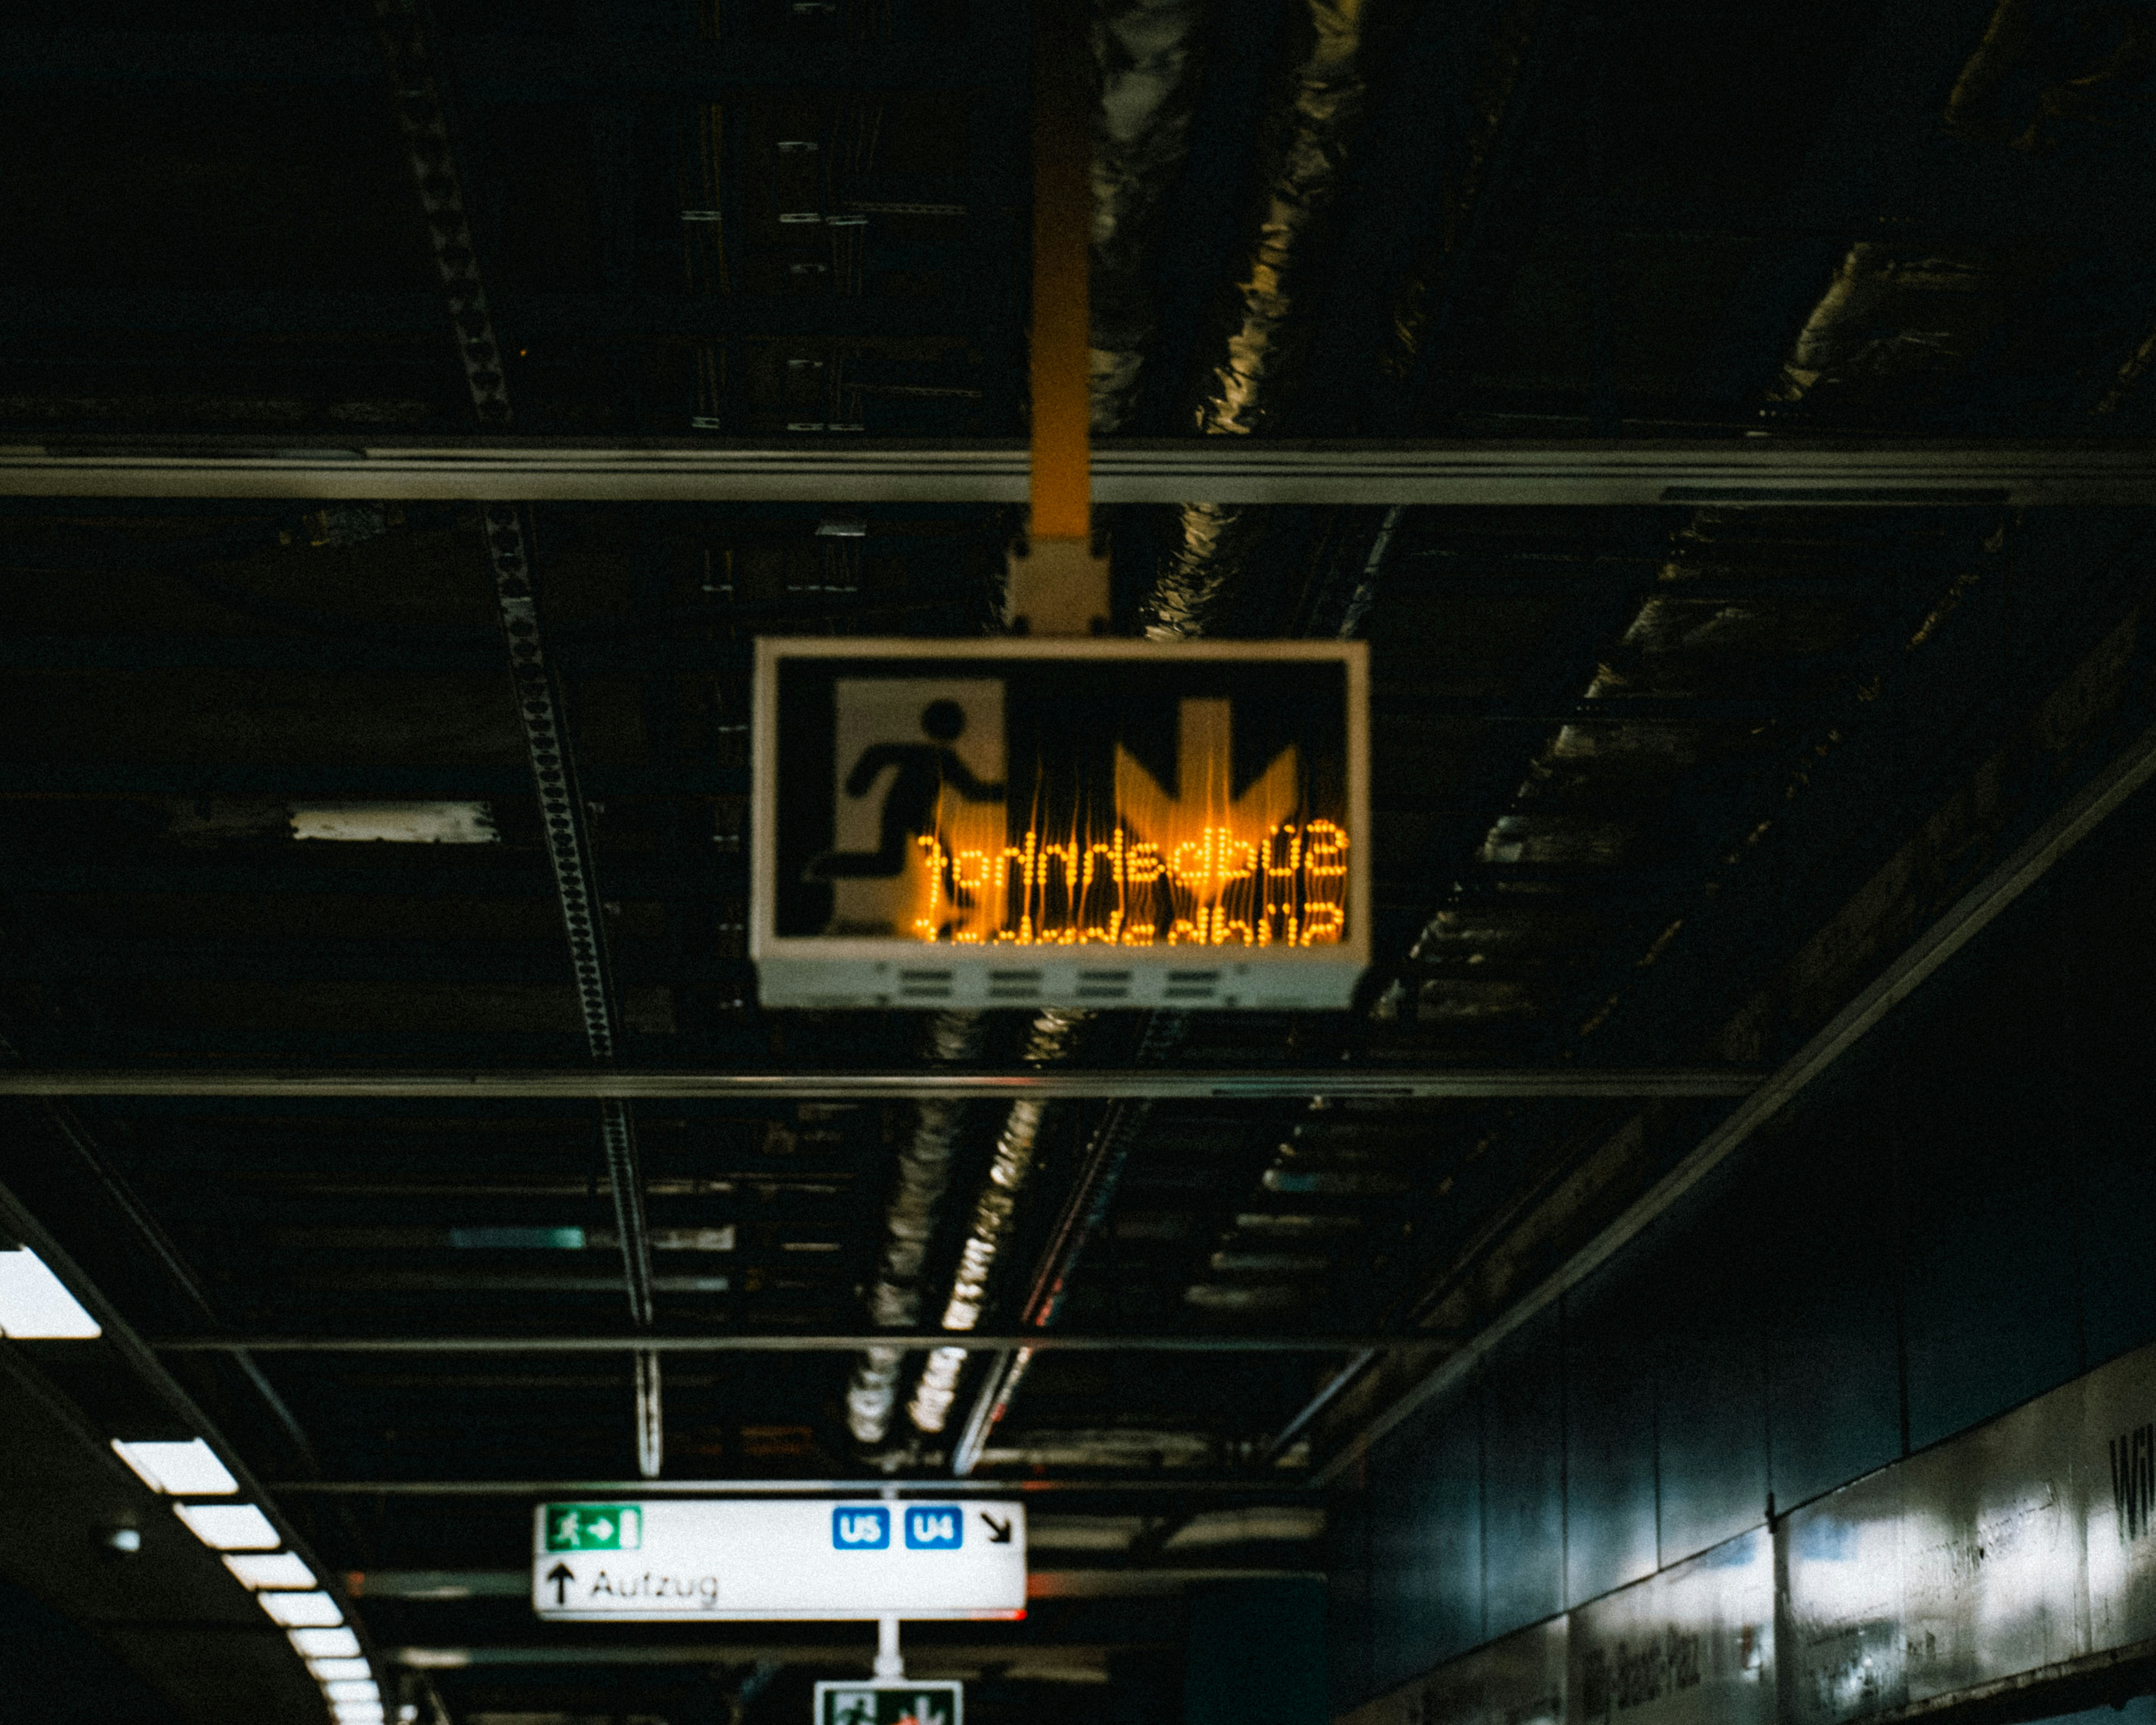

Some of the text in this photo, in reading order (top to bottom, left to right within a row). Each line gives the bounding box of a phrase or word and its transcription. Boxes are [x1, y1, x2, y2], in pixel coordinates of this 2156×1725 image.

[840, 1514, 954, 1543] U5 U4
[591, 1571, 717, 1611] Aufzug
